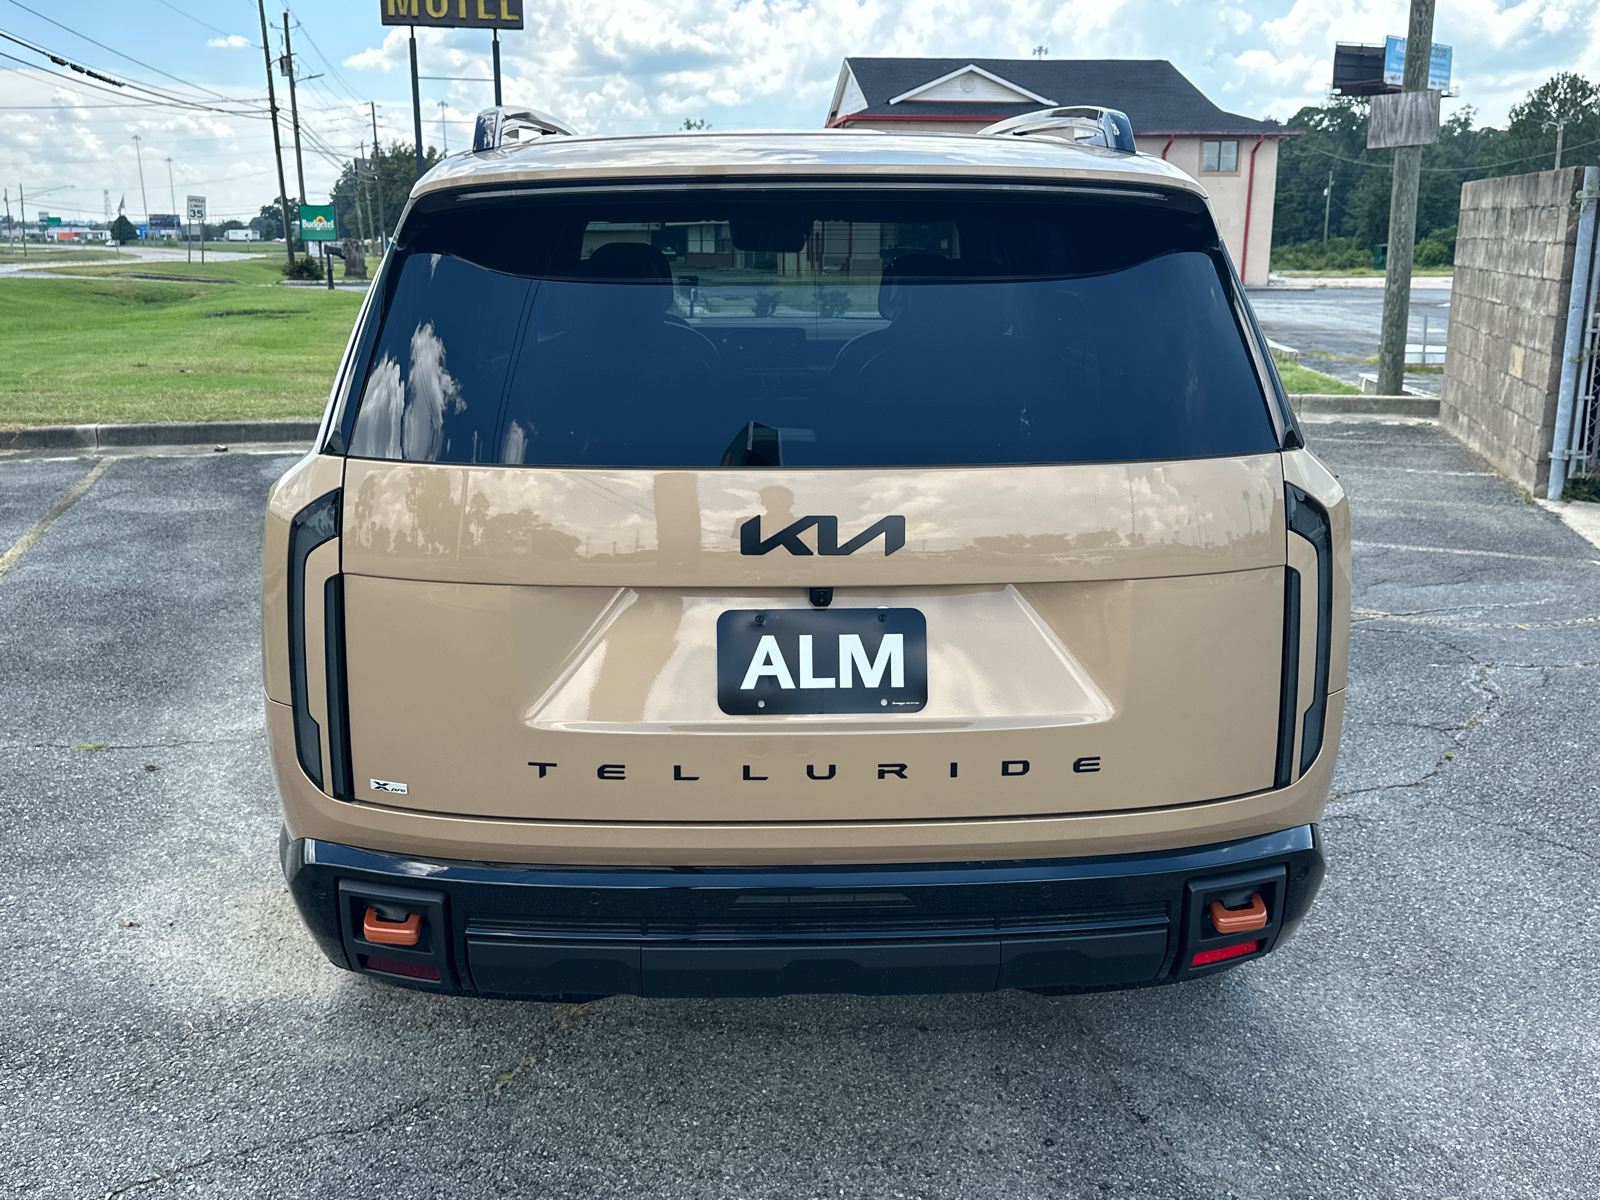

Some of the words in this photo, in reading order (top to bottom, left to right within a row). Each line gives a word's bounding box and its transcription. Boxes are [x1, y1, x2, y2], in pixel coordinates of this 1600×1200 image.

[190, 209, 204, 219] 35
[302, 219, 334, 231] Budgetel
[740, 514, 906, 557] KIA
[740, 633, 905, 690] ALM
[527, 756, 1101, 781] TELLURIDE
